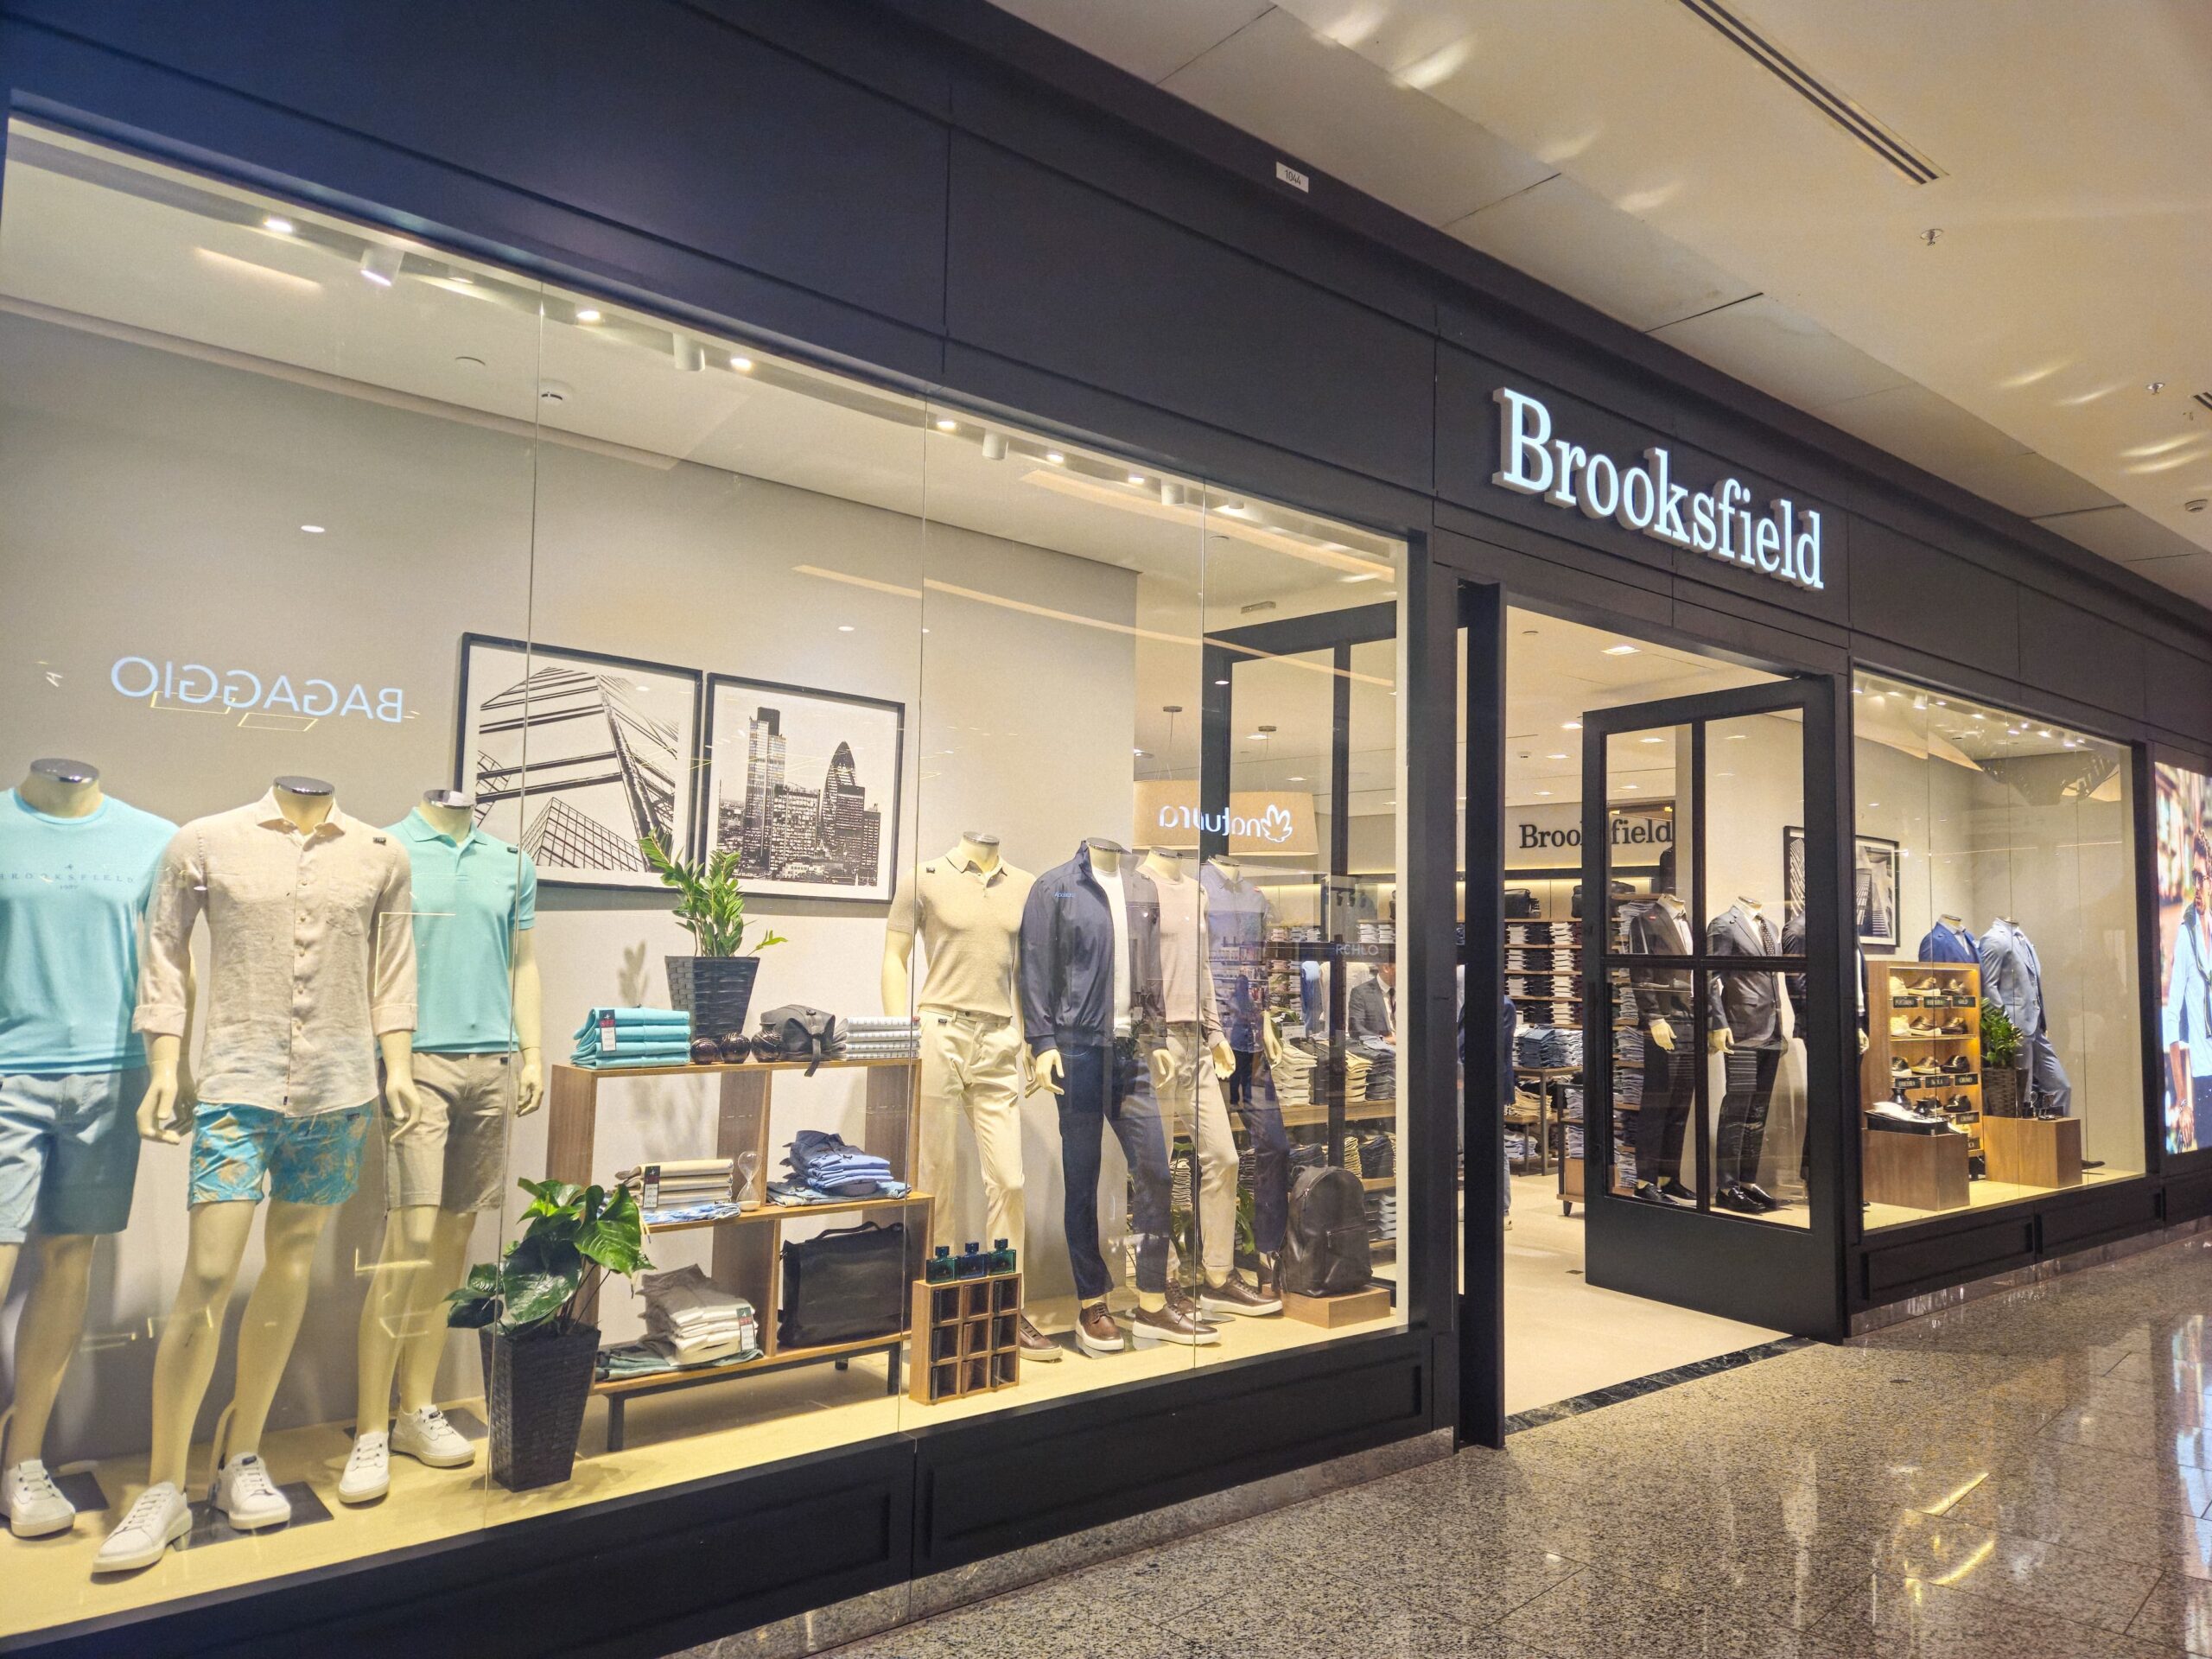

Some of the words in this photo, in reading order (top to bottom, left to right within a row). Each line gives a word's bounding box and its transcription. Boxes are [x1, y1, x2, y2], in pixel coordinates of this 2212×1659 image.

[1284, 169, 1301, 186] 1044
[1493, 387, 1824, 590] Brooksfield
[1519, 818, 1673, 849] Broofield
